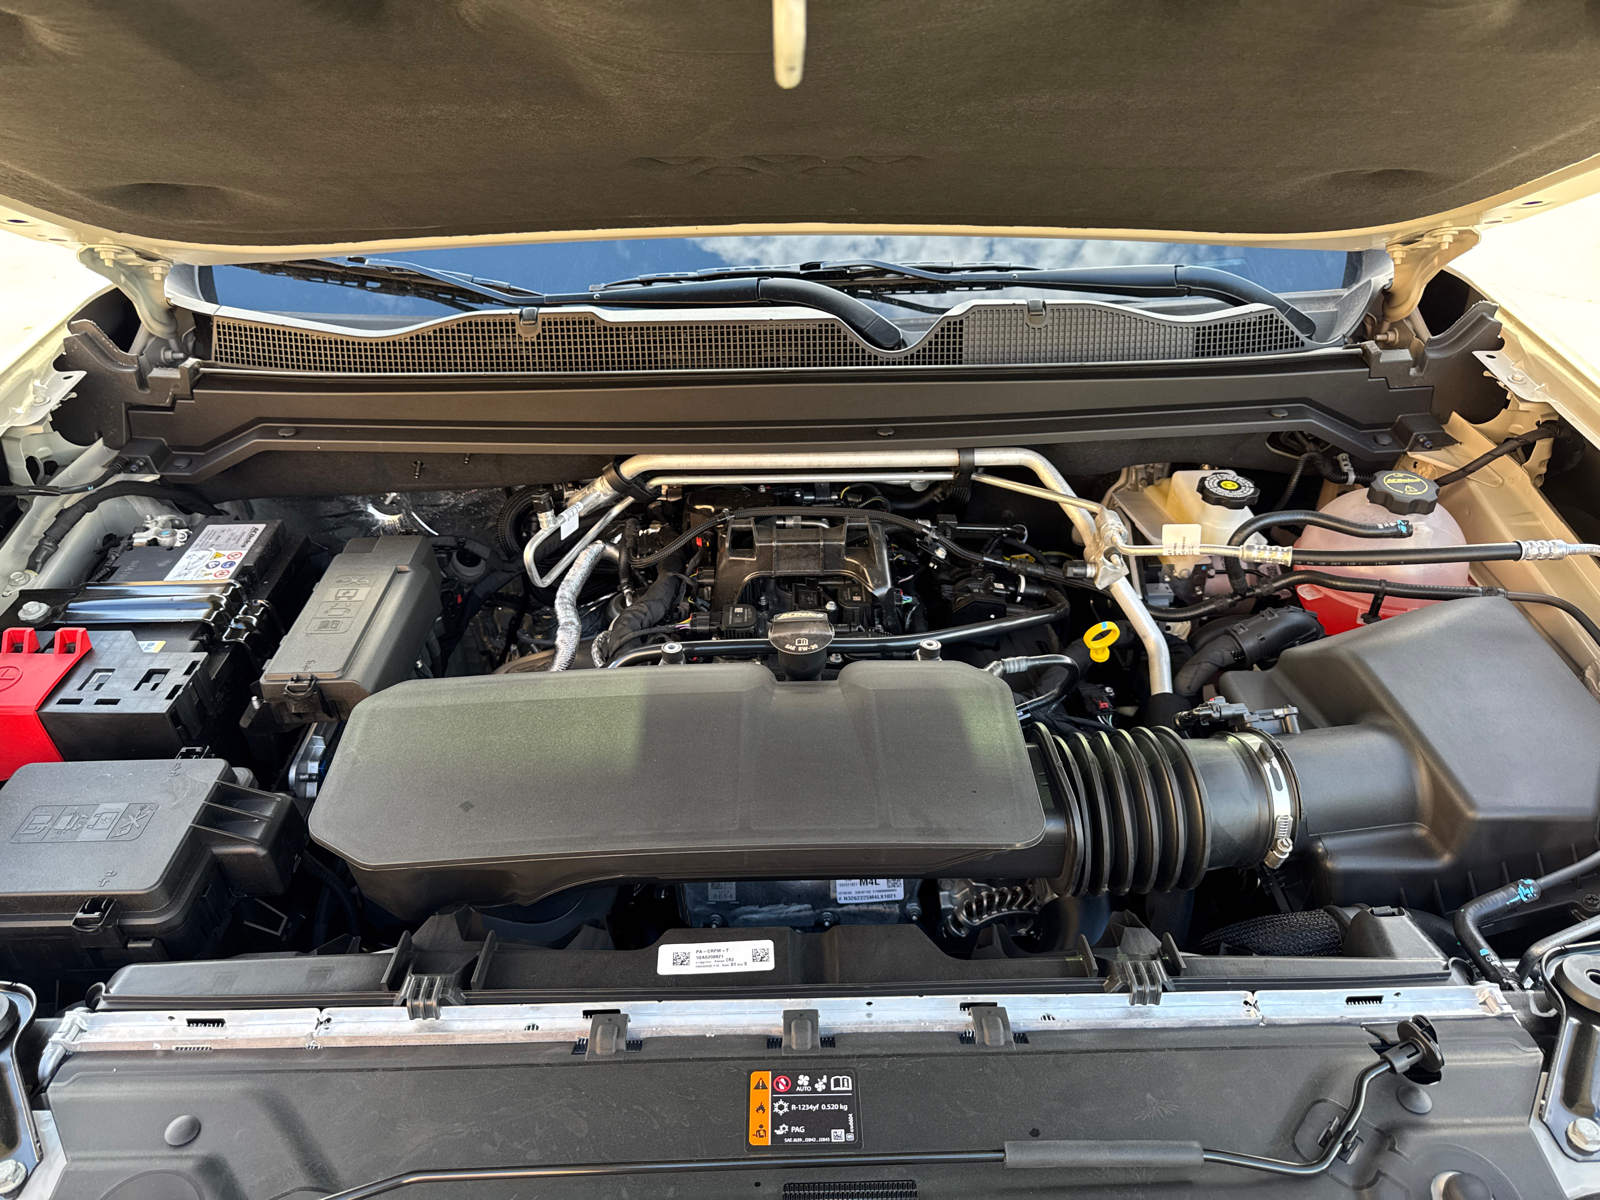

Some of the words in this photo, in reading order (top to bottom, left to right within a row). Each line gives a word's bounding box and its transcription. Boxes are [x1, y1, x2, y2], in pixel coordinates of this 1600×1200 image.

[784, 643, 796, 651] SAE
[791, 1103, 819, 1112] R-1234yf
[839, 1103, 848, 1111] kg
